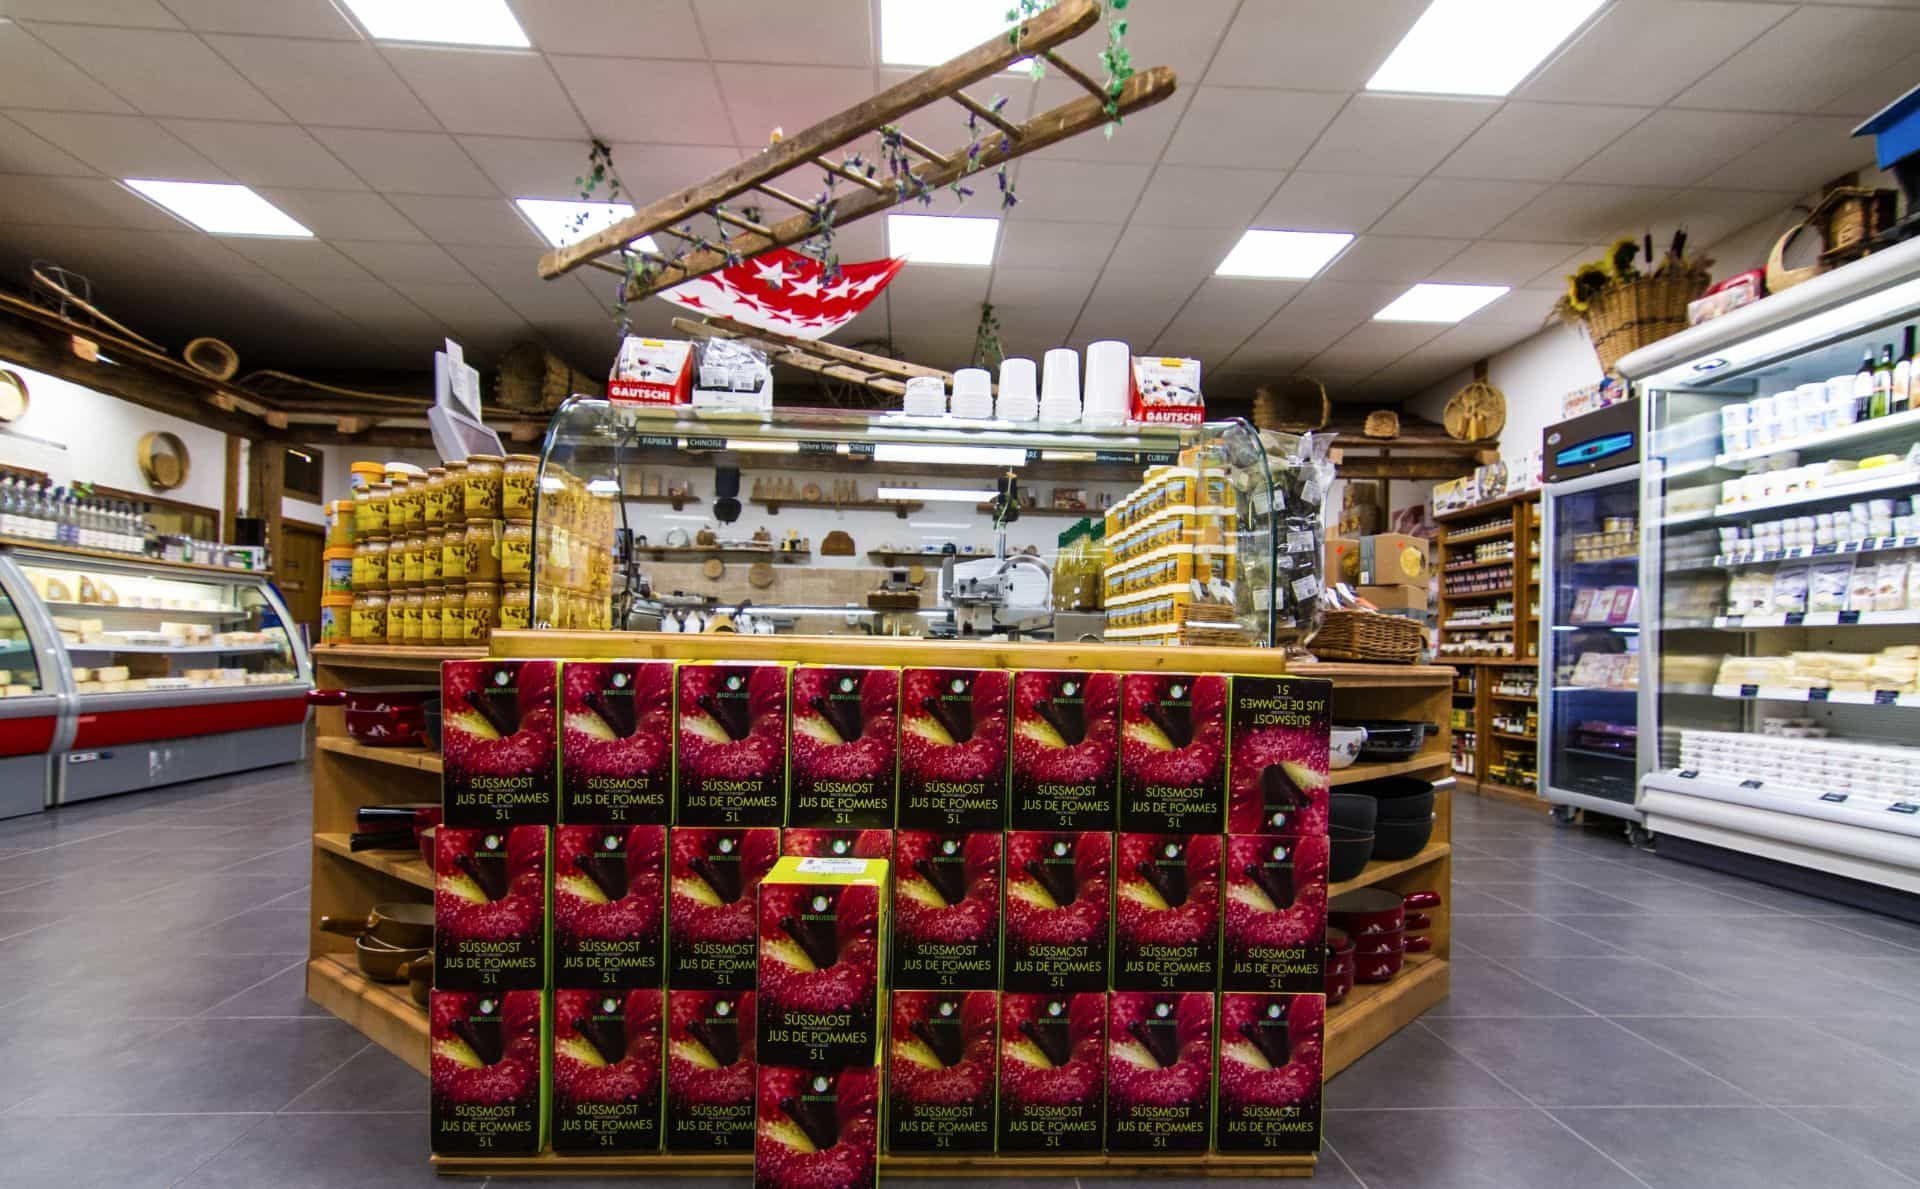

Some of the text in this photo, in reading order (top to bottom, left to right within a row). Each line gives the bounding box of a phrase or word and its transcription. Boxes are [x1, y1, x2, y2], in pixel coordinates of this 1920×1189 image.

[611, 386, 670, 400] GAUTSCHI
[1146, 411, 1202, 422] GAUTSCHI
[1240, 698, 1323, 712] JUS DE POMMES
[471, 776, 533, 790] SÜSSMOST
[588, 777, 649, 791] SÜSSMOST
[702, 779, 763, 792] SÜSSMOST
[814, 780, 873, 794] SÜSSMOST
[925, 782, 984, 794] SÜSSMOST
[1037, 783, 1096, 796] SÜSSMOST
[1145, 785, 1203, 797] SÜSSMOST
[456, 791, 549, 805] JUS DE POMMES
[573, 792, 664, 805] JUS DE POMMES
[688, 794, 777, 807] JUS DE POMMES
[799, 795, 887, 809] JUS DE POMMES
[909, 797, 998, 811] JUS DE POMMES
[1022, 799, 1109, 812] JUS DE POMMES
[1131, 800, 1216, 813] JUS DE POMMES
[459, 940, 520, 953] SÜSSMOST
[579, 940, 640, 953] SÜSSMOST
[694, 942, 754, 955] SÜSSMOST
[917, 943, 977, 955] SÜSSMOST
[1029, 944, 1087, 957] SÜSSMOST
[1139, 945, 1198, 958] SÜSSMOST
[1248, 946, 1305, 959] SÜSSMOST
[445, 956, 535, 969] JUS DE POMMES
[564, 956, 655, 968] JUS DE POMMES
[680, 958, 757, 970] JUS DE POMM
[904, 959, 991, 971] JUS DE POMMES
[1014, 959, 1101, 972] JUS DE POMMES
[1126, 959, 1211, 973] JUS DE POMMES
[1234, 961, 1318, 974] JUS DE POMMES
[784, 1012, 851, 1026] SÜSSMOST
[768, 1030, 866, 1044] JUS DE POMMES
[455, 1104, 516, 1117] SÜSSMOST
[577, 1103, 638, 1115] SÜSSMOST
[692, 1104, 750, 1117] SÜSSMOST
[915, 1104, 973, 1117] SÜSSMOST
[1024, 1104, 1082, 1117] SÜSSMOST
[1131, 1106, 1189, 1118] SÜSSMOST
[1243, 1106, 1300, 1118] SÜSSMOST
[441, 1120, 531, 1132] JUS DE POMMES
[561, 1119, 652, 1131] JUS DE POMMES
[678, 1119, 754, 1131] JUS DE POMM
[900, 1121, 987, 1132] JUS DE POMMES
[1010, 1121, 1096, 1132] JUS DE POMMES
[1117, 1121, 1203, 1133] JUS DE POMMES
[1228, 1121, 1313, 1133] JUS DE POMMES
